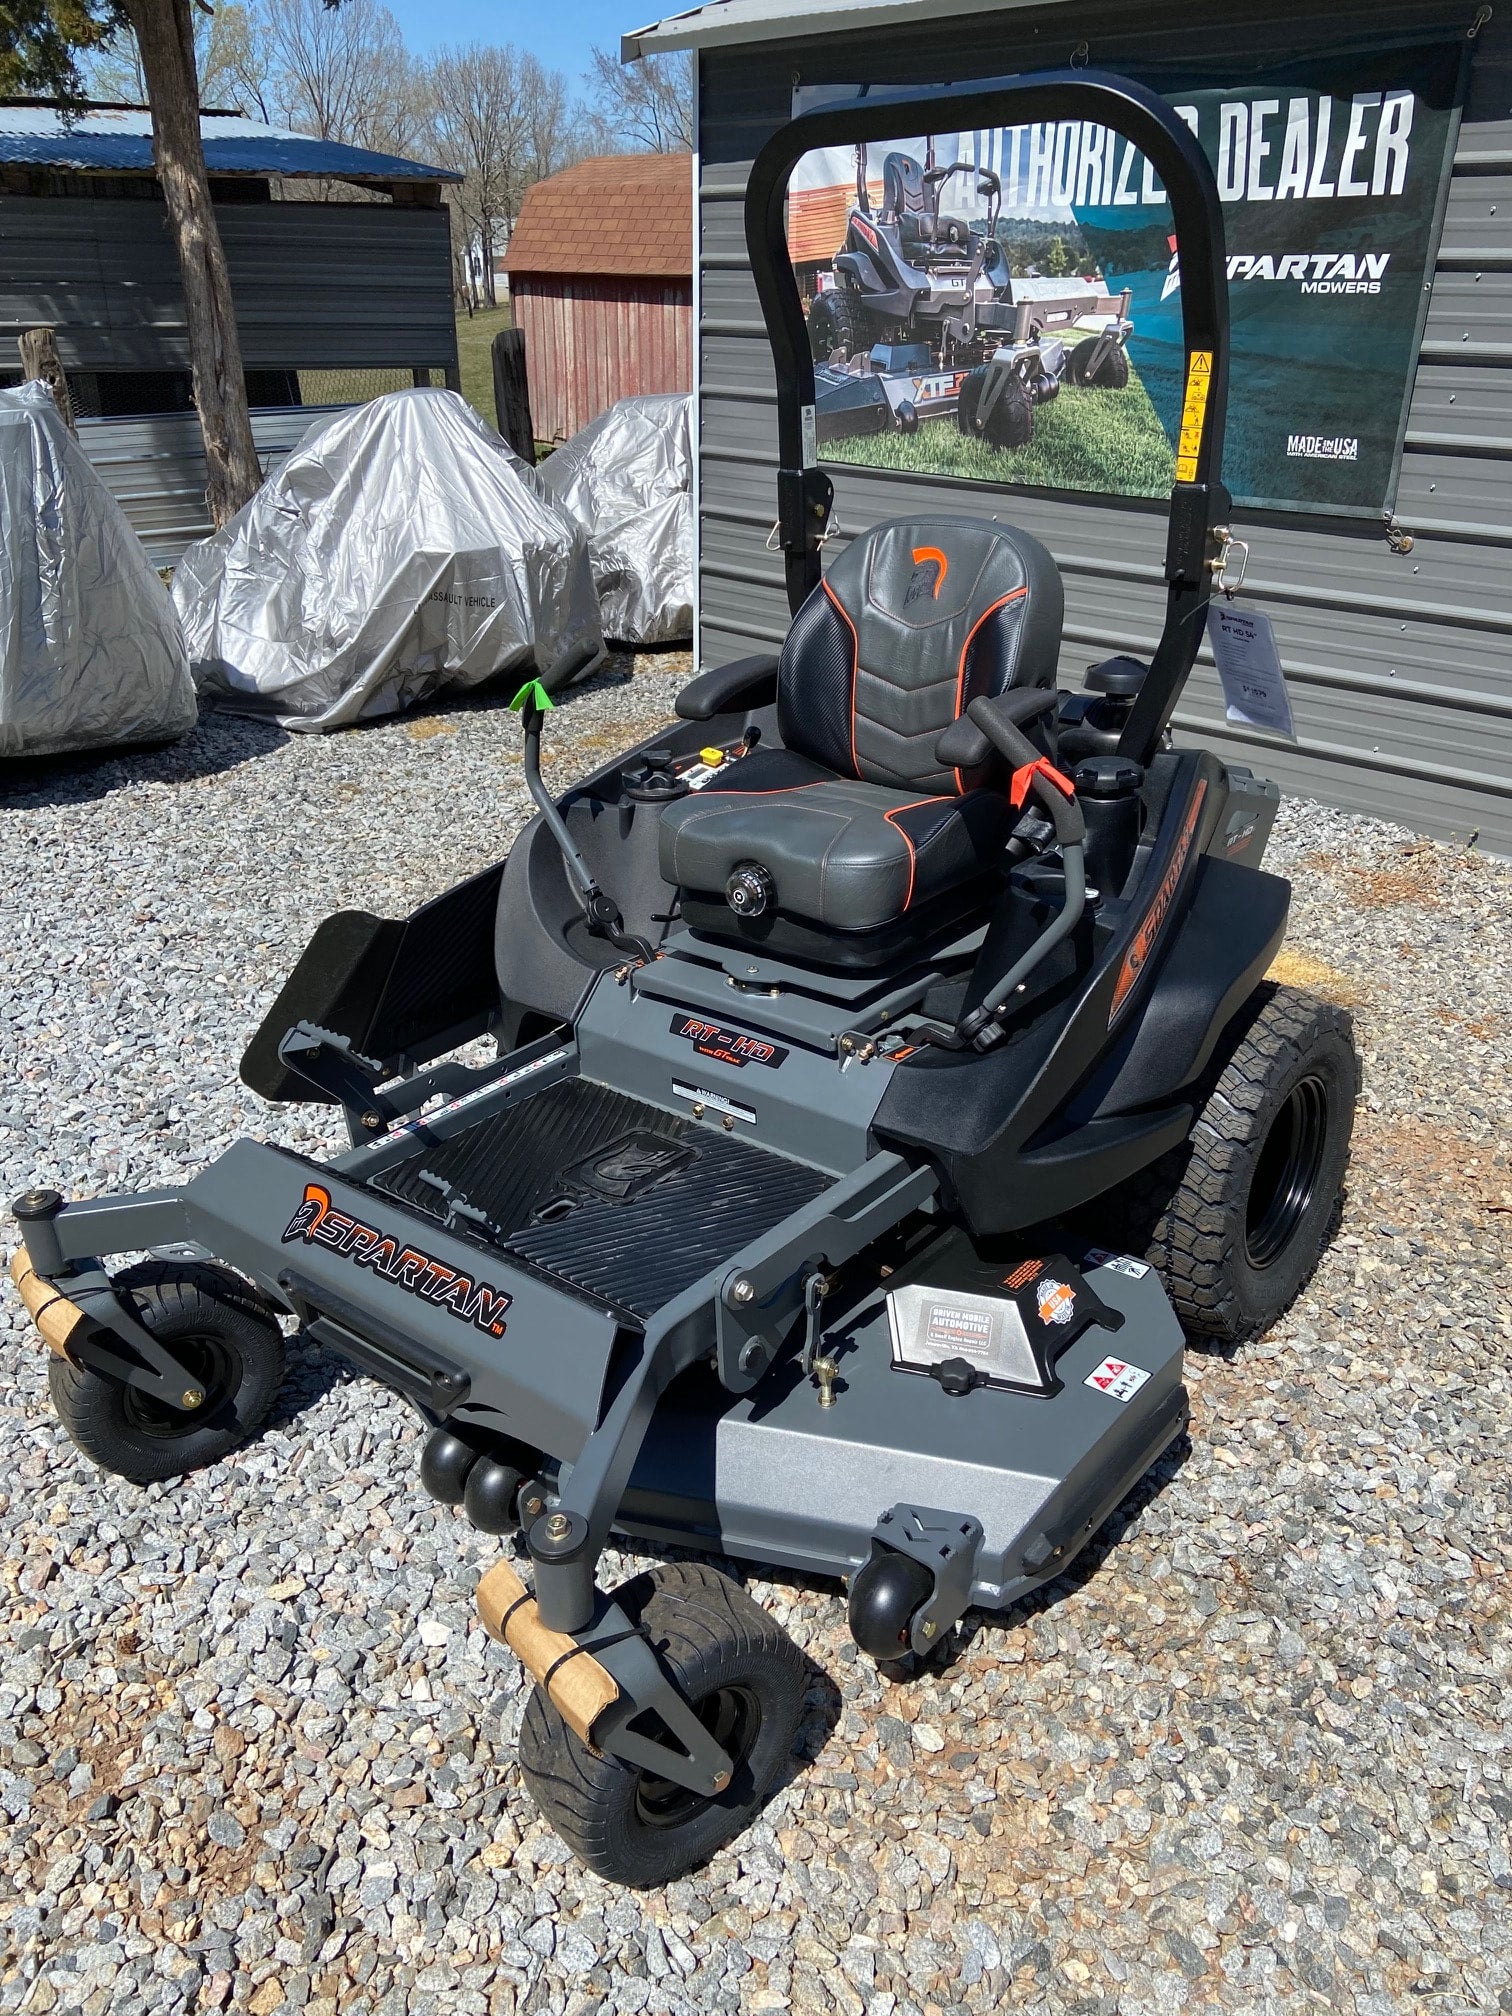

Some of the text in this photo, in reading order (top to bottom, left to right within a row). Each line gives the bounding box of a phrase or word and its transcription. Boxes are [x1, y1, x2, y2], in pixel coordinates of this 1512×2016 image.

[1216, 90, 1414, 202] DEALER
[1226, 253, 1390, 280] PARTAN
[1301, 281, 1381, 294] MOWERS
[1287, 435, 1323, 454] MADE
[1333, 438, 1358, 456] USA
[464, 596, 495, 608] VEHICLE
[314, 1211, 509, 1336] SPARTAN TM
[1048, 1294, 1063, 1309] USA
[933, 1308, 990, 1323] DRIVEN MOBILE
[932, 1317, 989, 1333] AUTOMOTIVE
